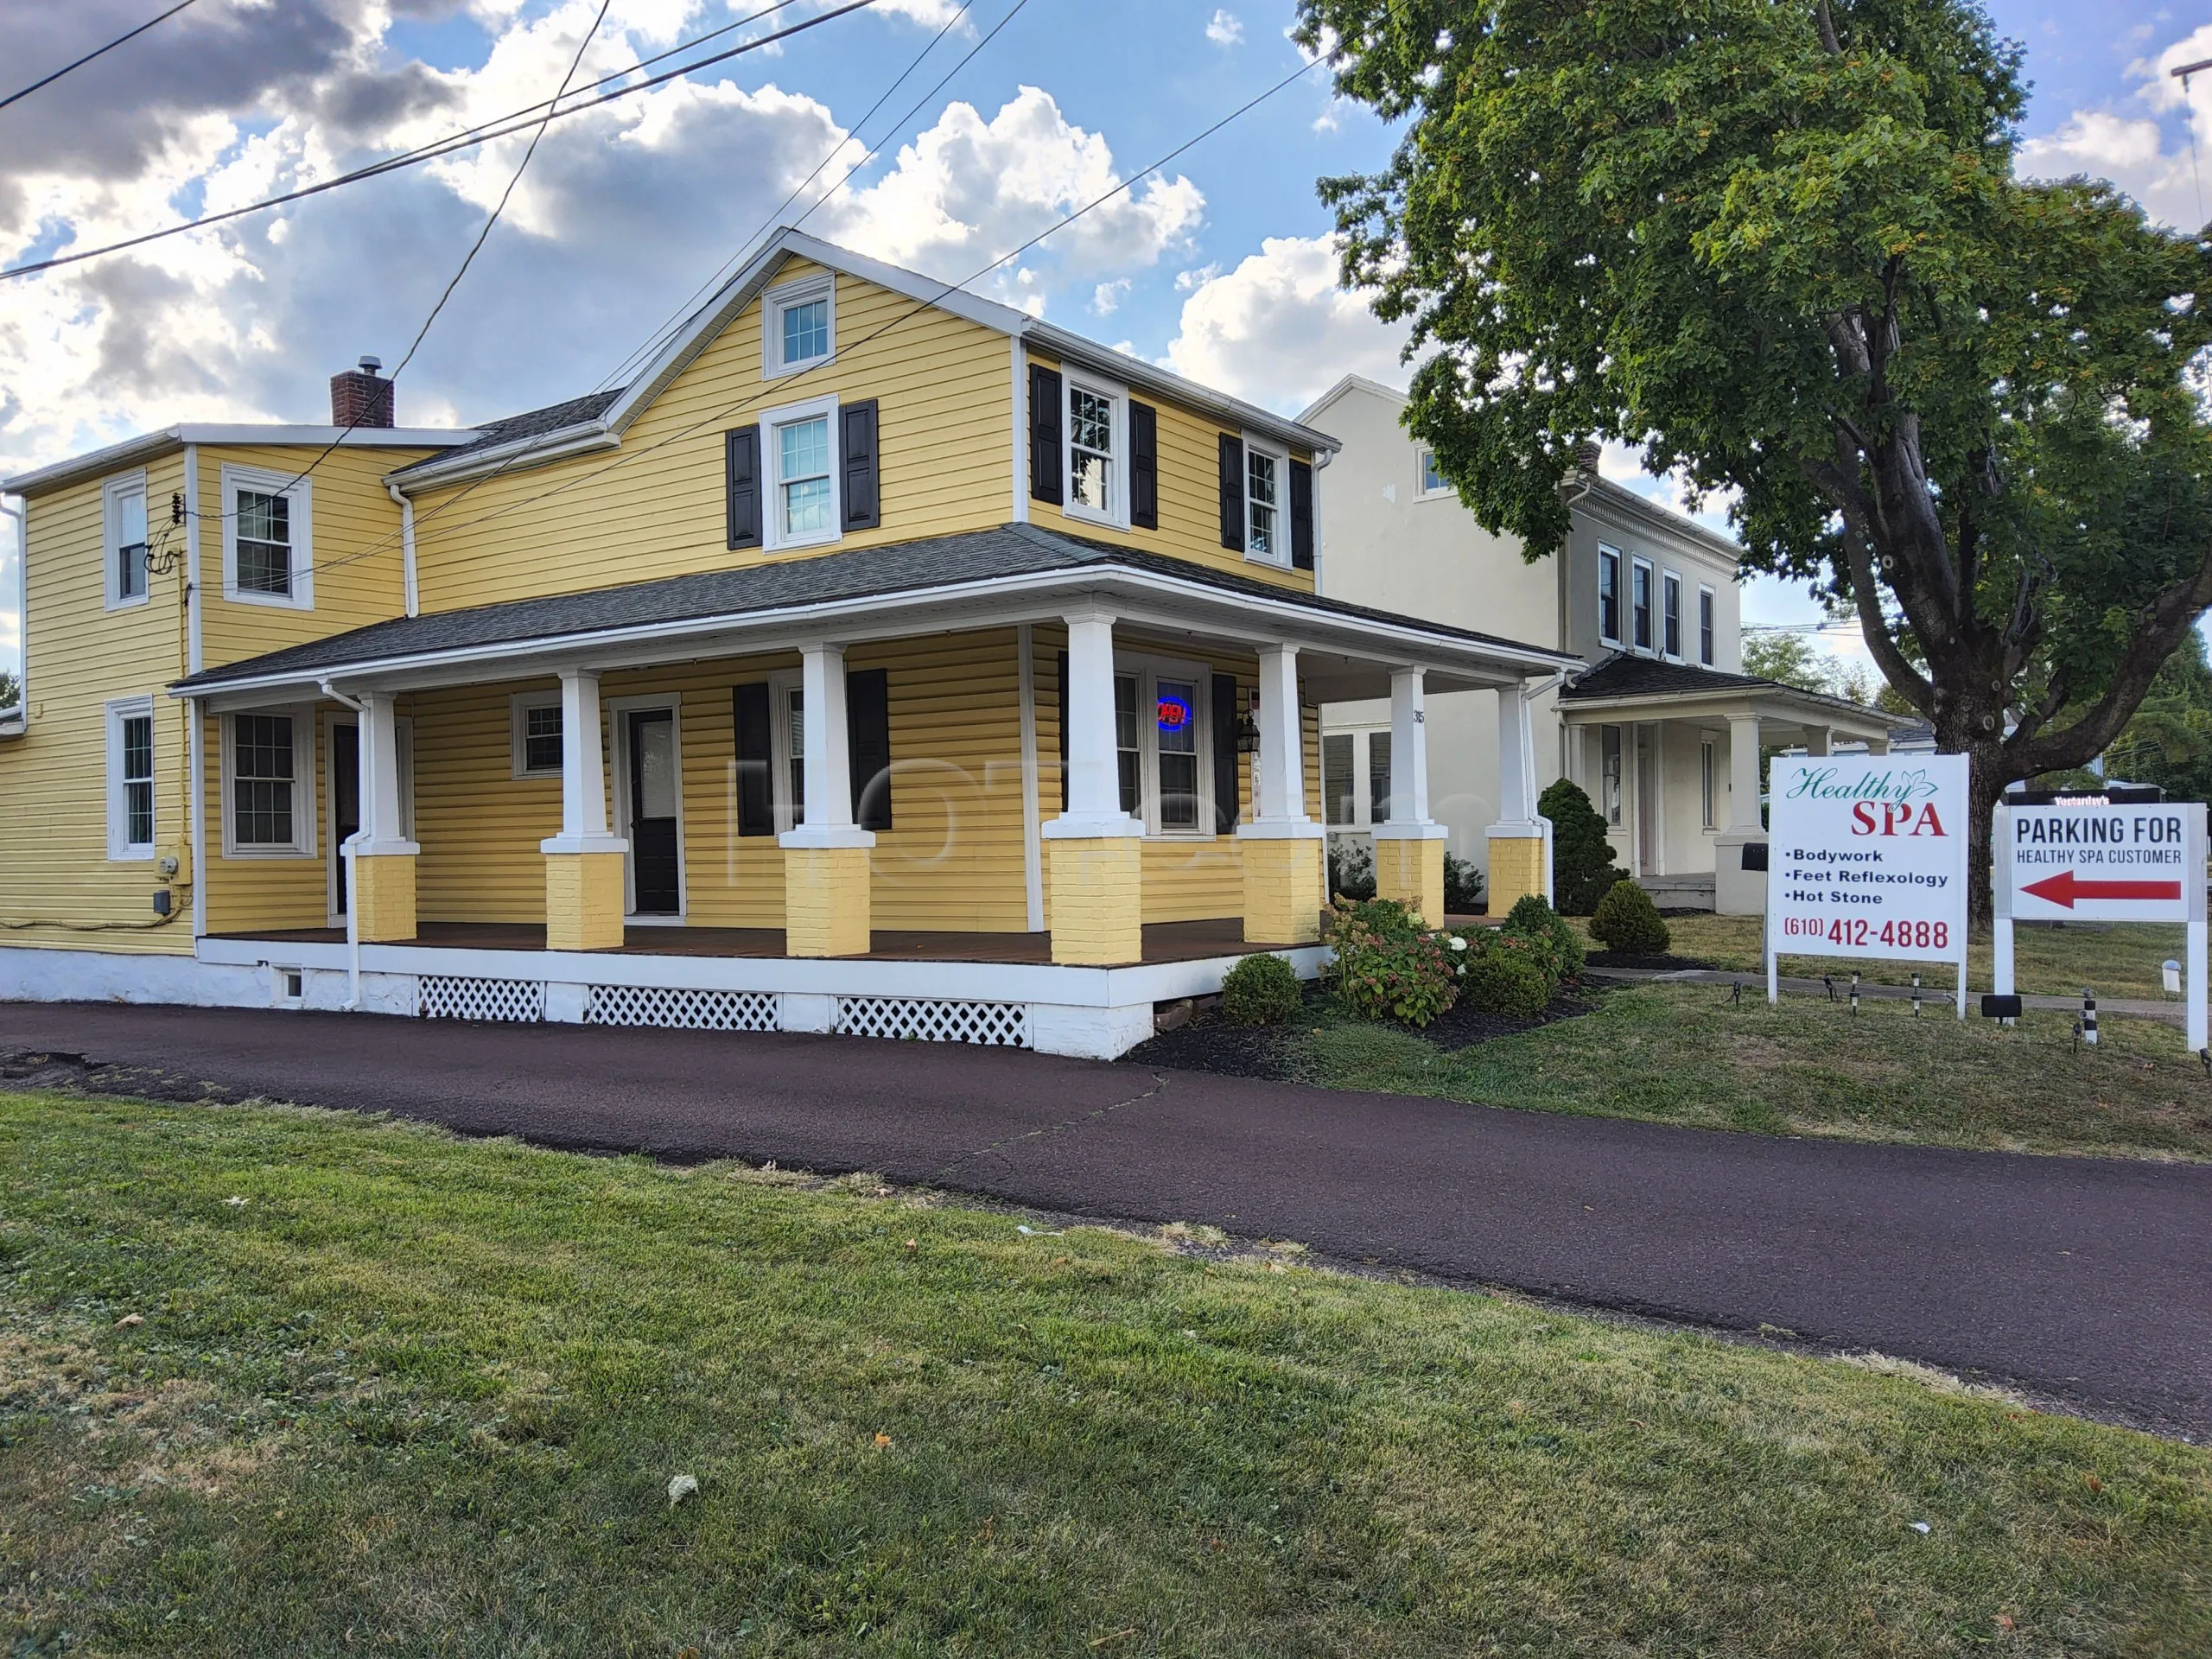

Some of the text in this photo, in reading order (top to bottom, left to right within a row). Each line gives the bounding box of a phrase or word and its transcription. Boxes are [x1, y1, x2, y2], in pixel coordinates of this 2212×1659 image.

[1156, 702, 1186, 725] OPEN
[1414, 709, 1425, 723] 315
[1786, 767, 1912, 813] Healthy
[1851, 800, 1949, 836] SPA
[2017, 817, 2182, 843] PARKING FOR
[1793, 849, 1884, 864] Bodywork
[2017, 849, 2182, 864] HEALTHY SPA CUSTOMER
[1793, 869, 1948, 888] Feet Reflexology
[1793, 890, 1883, 904] Hot Stone
[1784, 917, 1948, 949] (610) 412-4888
